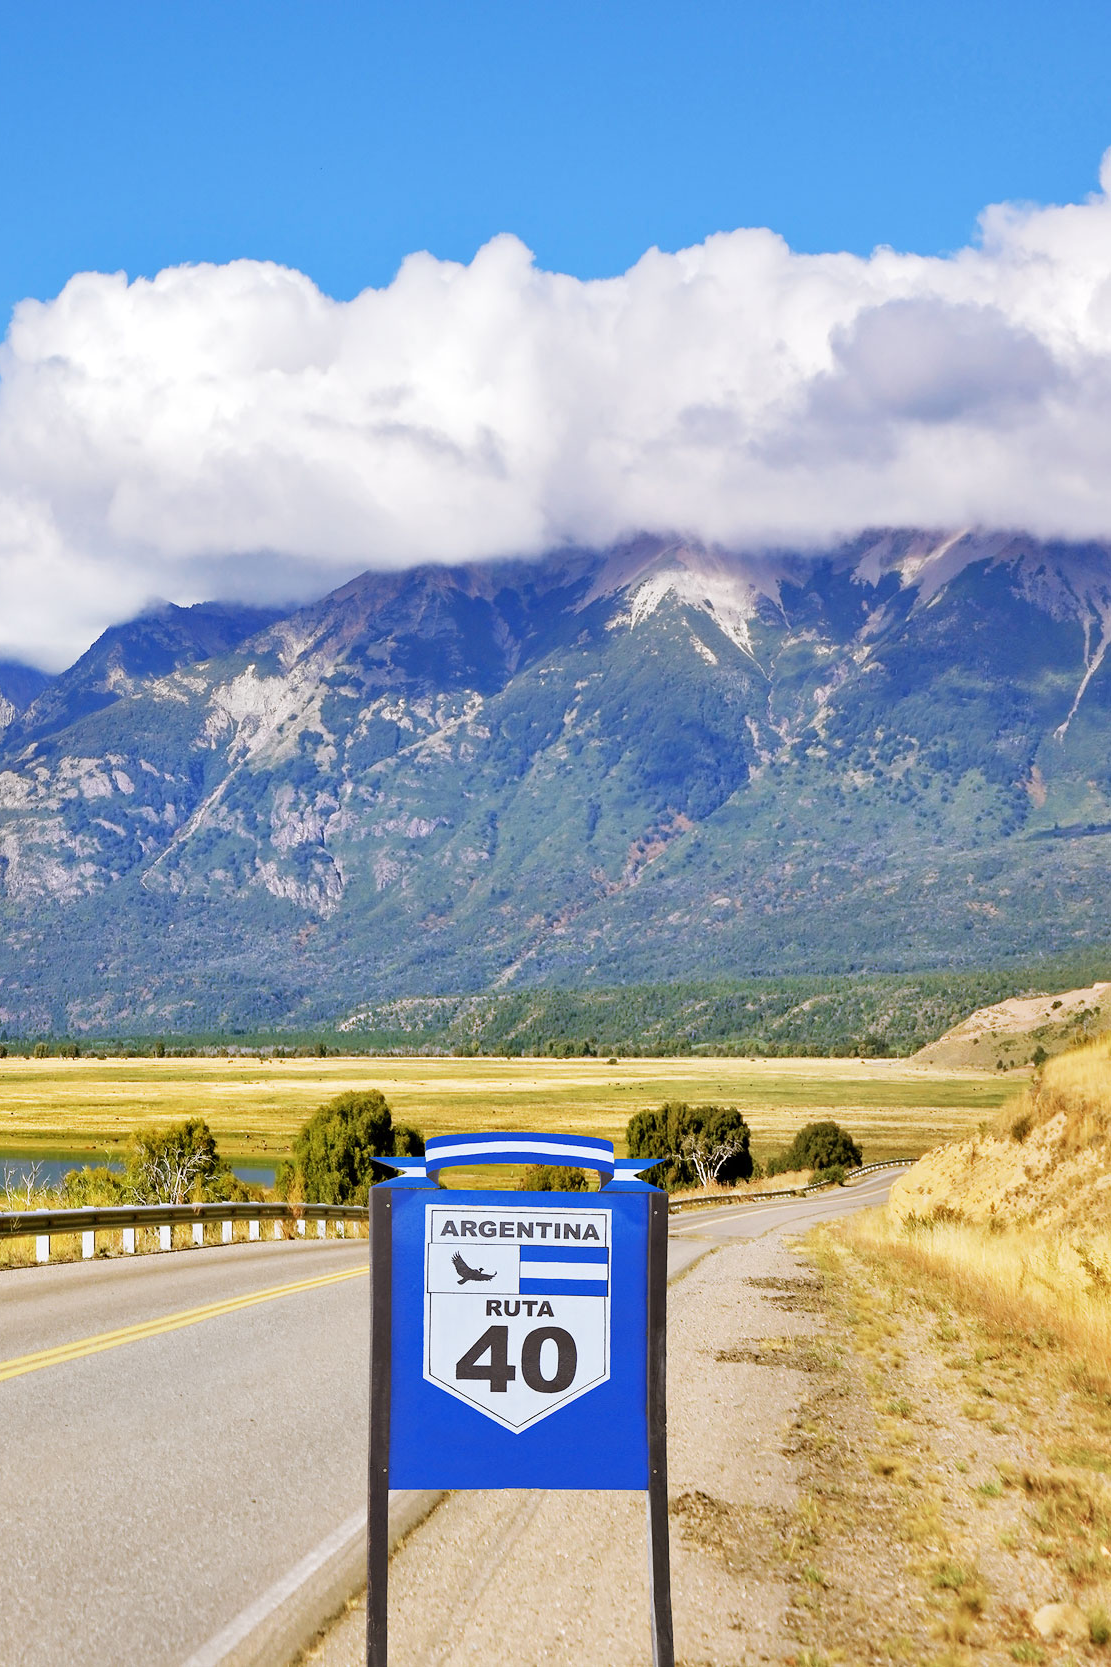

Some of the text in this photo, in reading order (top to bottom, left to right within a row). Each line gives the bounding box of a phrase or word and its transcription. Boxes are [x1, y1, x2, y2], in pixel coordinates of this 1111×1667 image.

[440, 1219, 601, 1242] ARGENTINA
[485, 1299, 555, 1318] RUTA
[455, 1325, 579, 1394] 40
